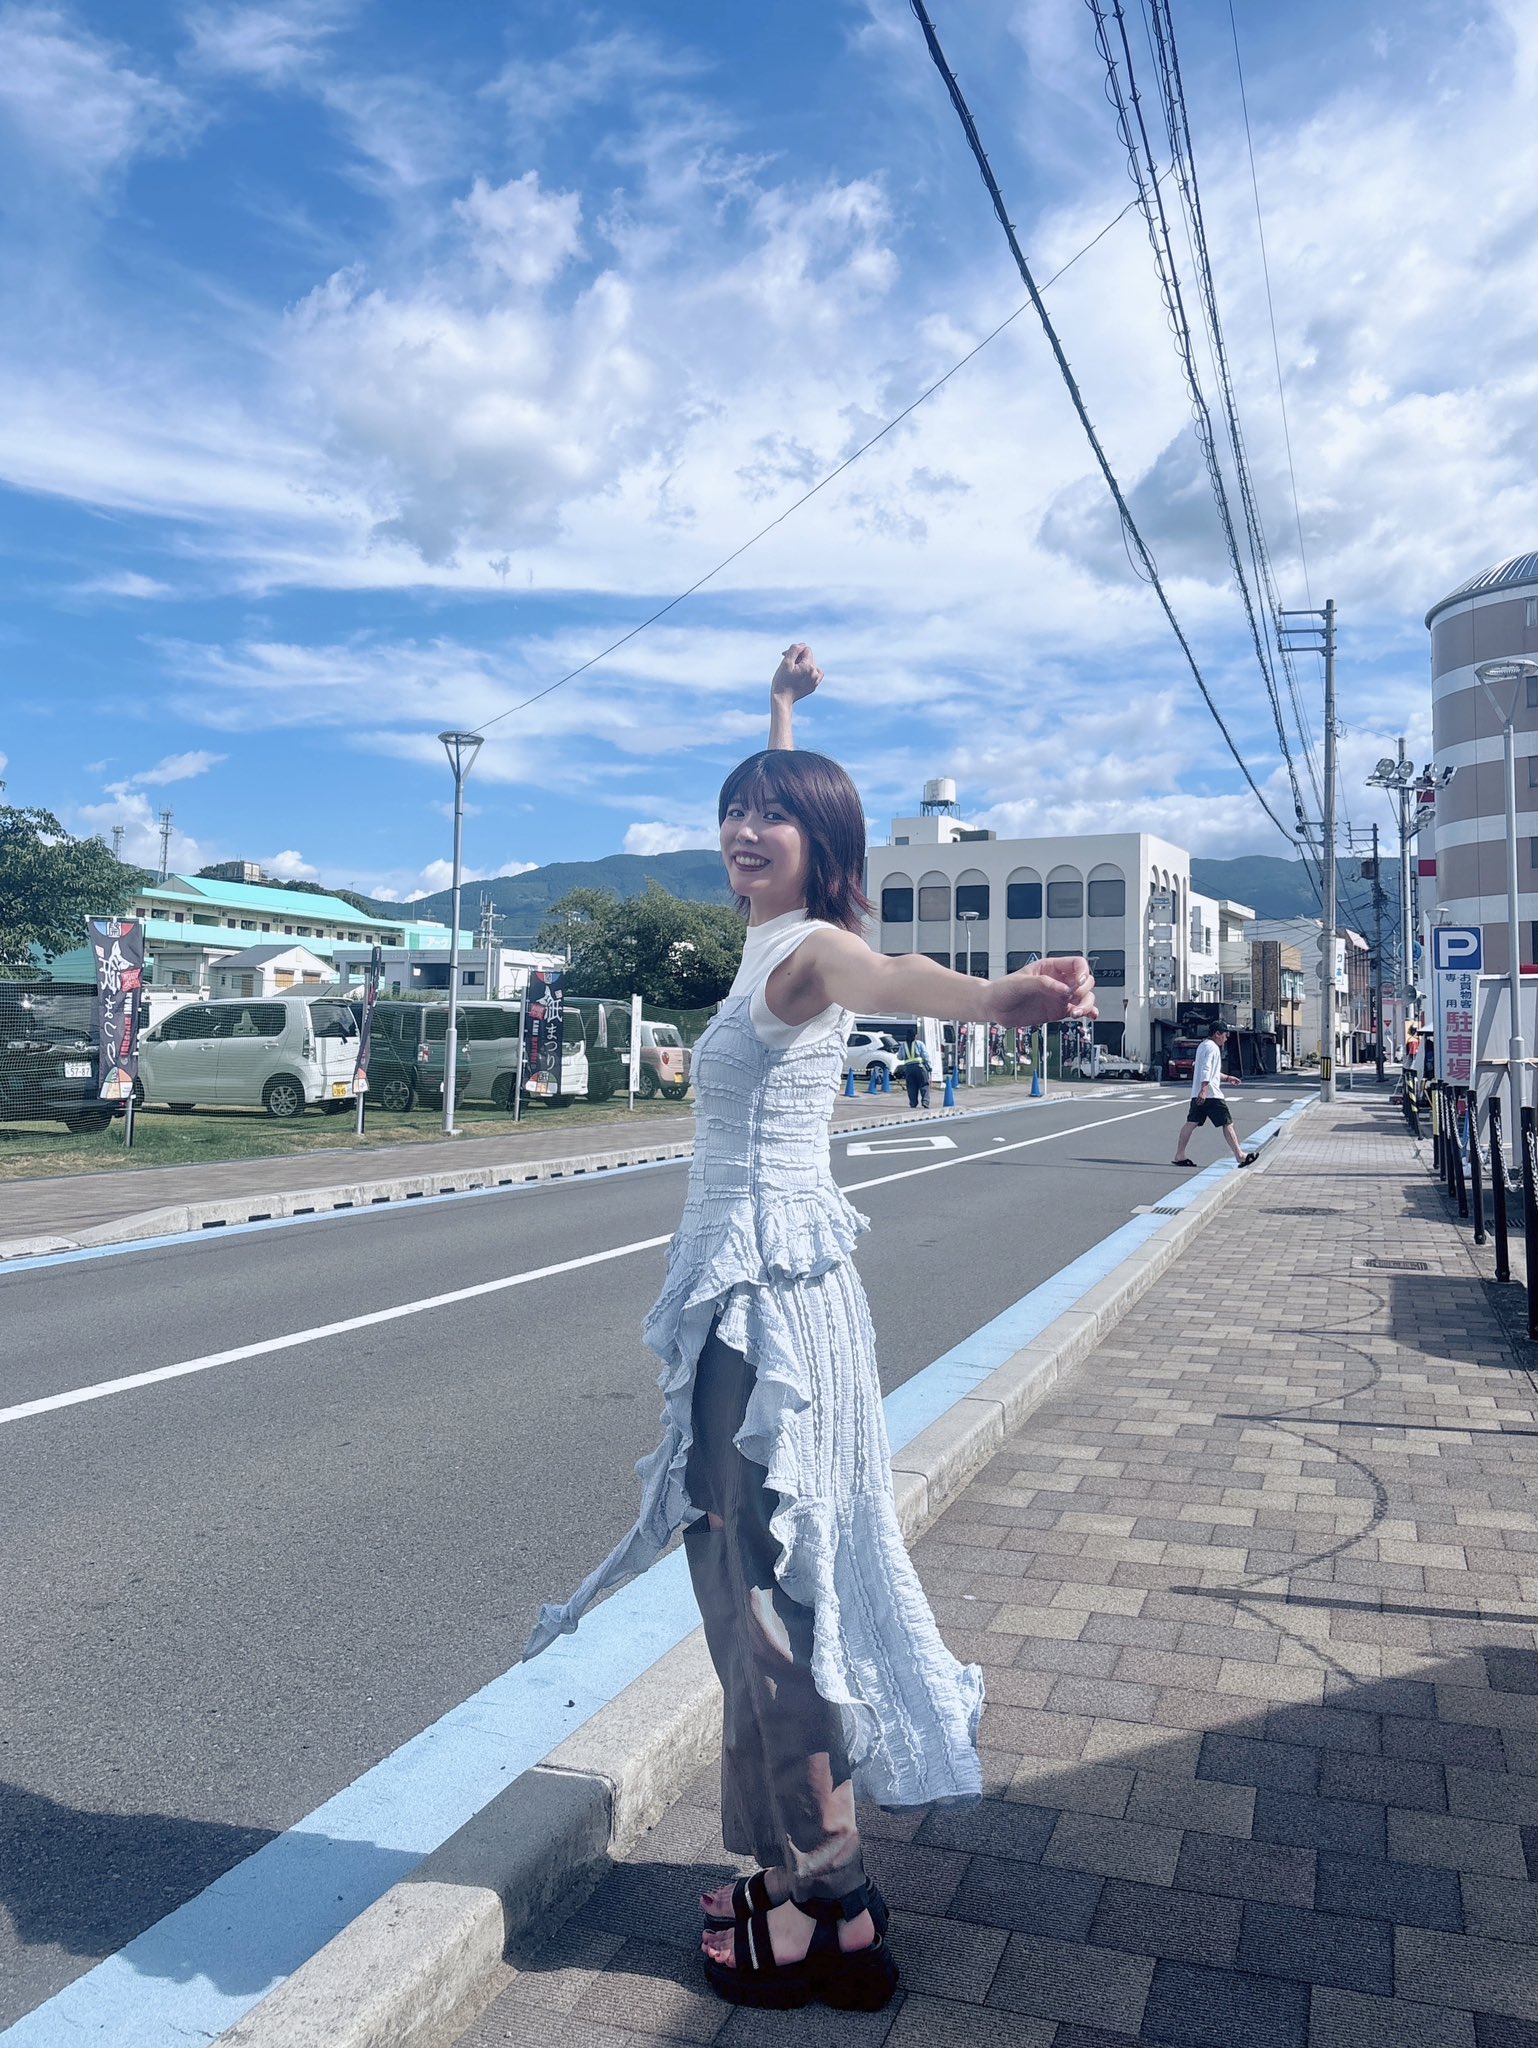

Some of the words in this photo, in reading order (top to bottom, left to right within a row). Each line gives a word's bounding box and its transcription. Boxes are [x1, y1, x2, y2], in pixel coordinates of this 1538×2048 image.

[1439, 931, 1478, 968] P
[1459, 973, 1473, 1009] お買物客
[536, 985, 563, 1070] 紙まつり
[1446, 1011, 1473, 1081] 駐車場
